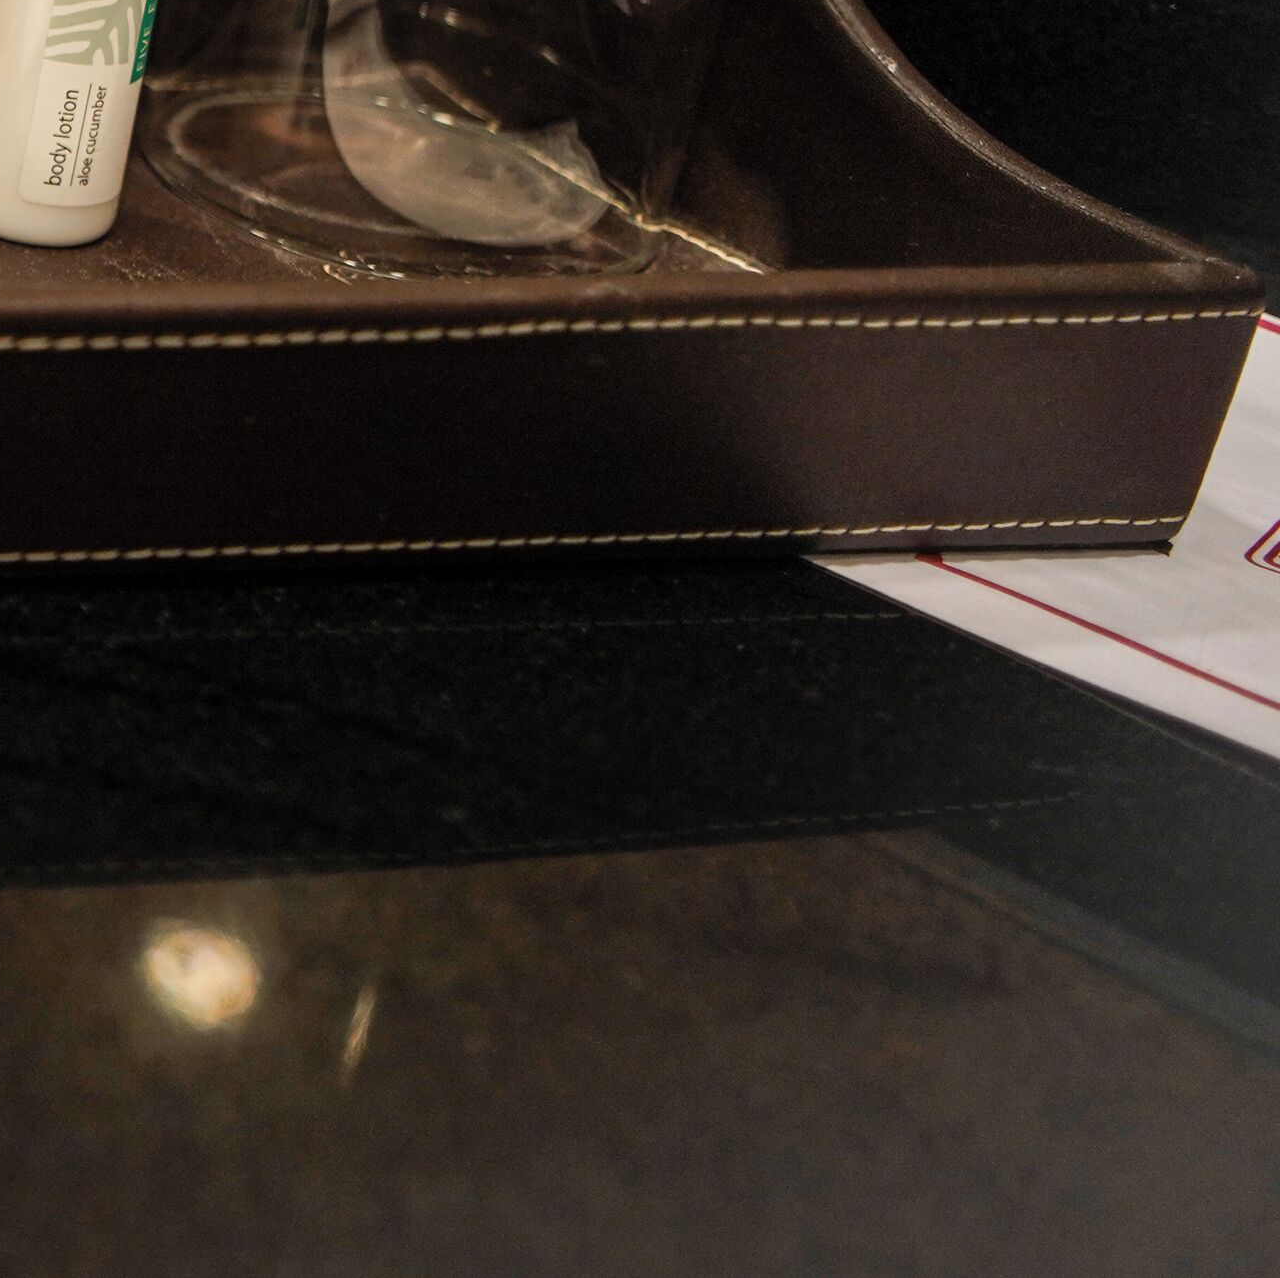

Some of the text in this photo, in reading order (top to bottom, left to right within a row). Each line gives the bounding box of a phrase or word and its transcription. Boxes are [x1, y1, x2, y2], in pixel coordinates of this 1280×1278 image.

[136, 26, 152, 73] FIVE
[43, 89, 79, 187] body lotion
[77, 85, 107, 186] aloe cucumber
